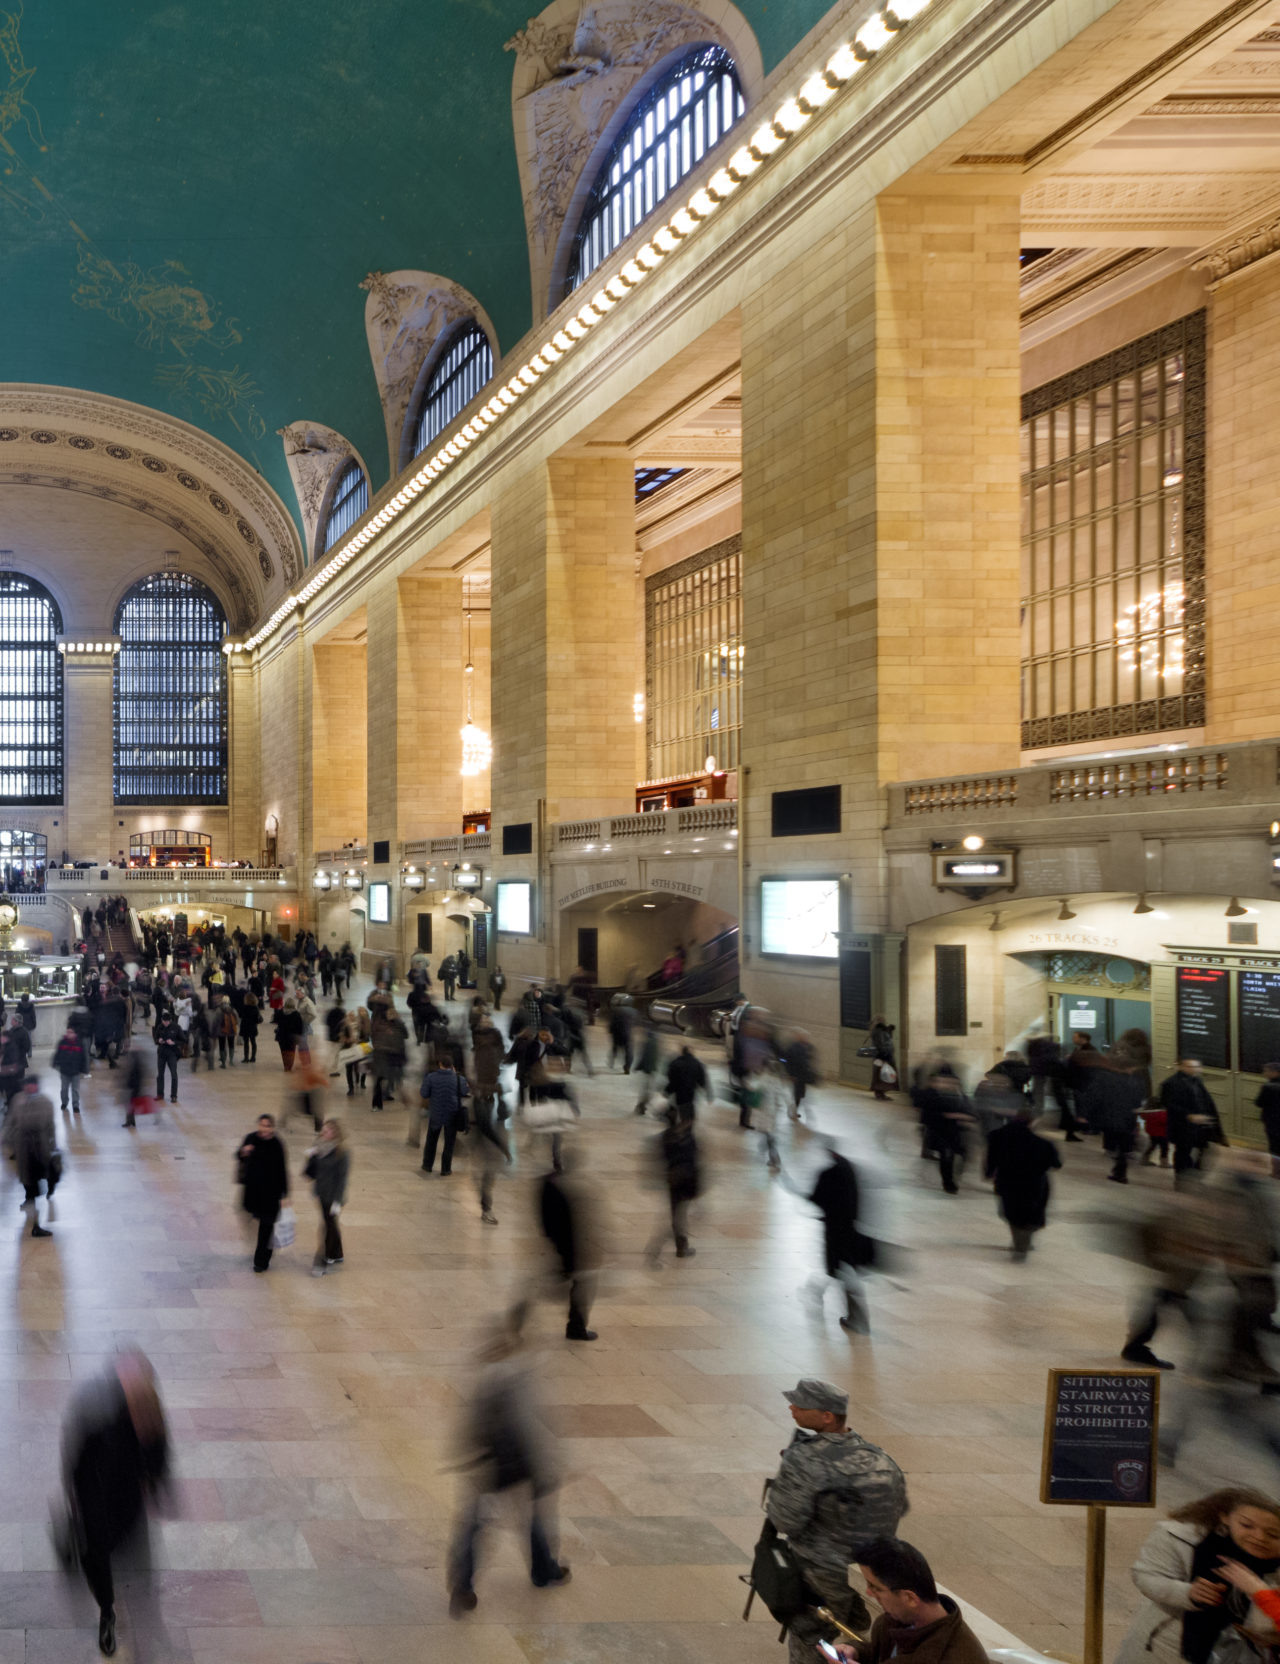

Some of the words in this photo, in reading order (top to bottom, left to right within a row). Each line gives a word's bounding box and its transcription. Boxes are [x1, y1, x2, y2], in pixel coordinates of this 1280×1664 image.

[595, 878, 627, 891] BUILDING
[650, 878, 670, 888] 45TH
[671, 879, 703, 896] STREET
[1028, 934, 1042, 944] 26
[1045, 933, 1099, 945] TRACKS
[1063, 1377, 1122, 1388] SITTING
[1126, 1378, 1149, 1388] ON
[1059, 1390, 1151, 1402] STAIRWAYS
[1057, 1403, 1070, 1413] IS
[1074, 1404, 1148, 1415] STRICTLY
[1055, 1417, 1152, 1429] PROHIBITED.
[1117, 1462, 1143, 1472] POLICE
